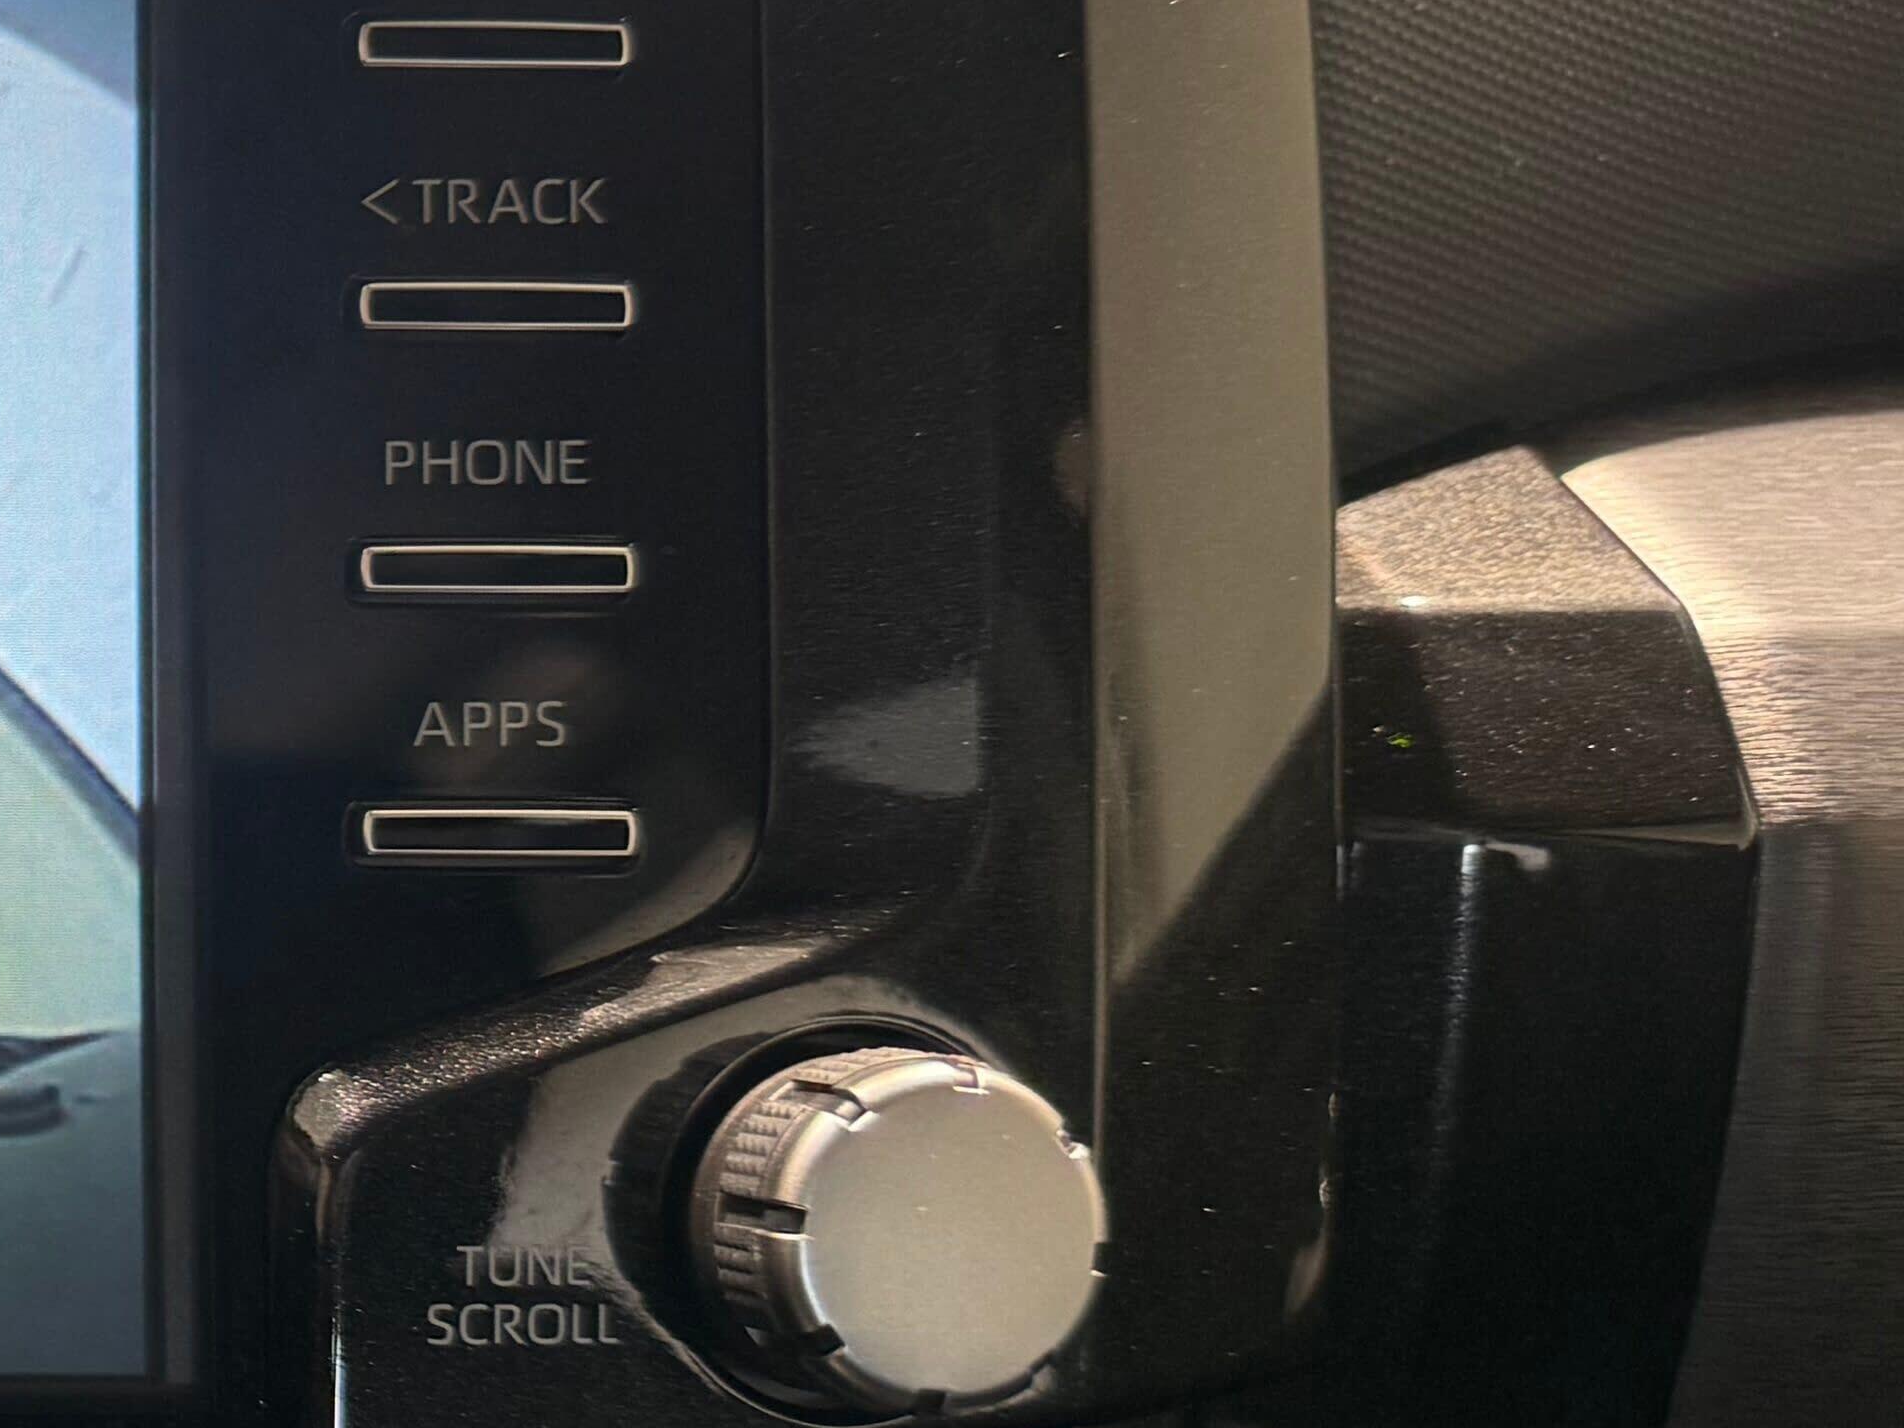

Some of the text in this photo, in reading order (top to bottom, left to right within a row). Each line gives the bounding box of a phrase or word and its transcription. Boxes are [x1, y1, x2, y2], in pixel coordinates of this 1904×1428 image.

[412, 179, 607, 224] TRACK
[385, 440, 590, 485] PHONE
[413, 701, 567, 748] APPS
[456, 1244, 592, 1288] TUNE
[427, 1303, 622, 1346] SCROLL
